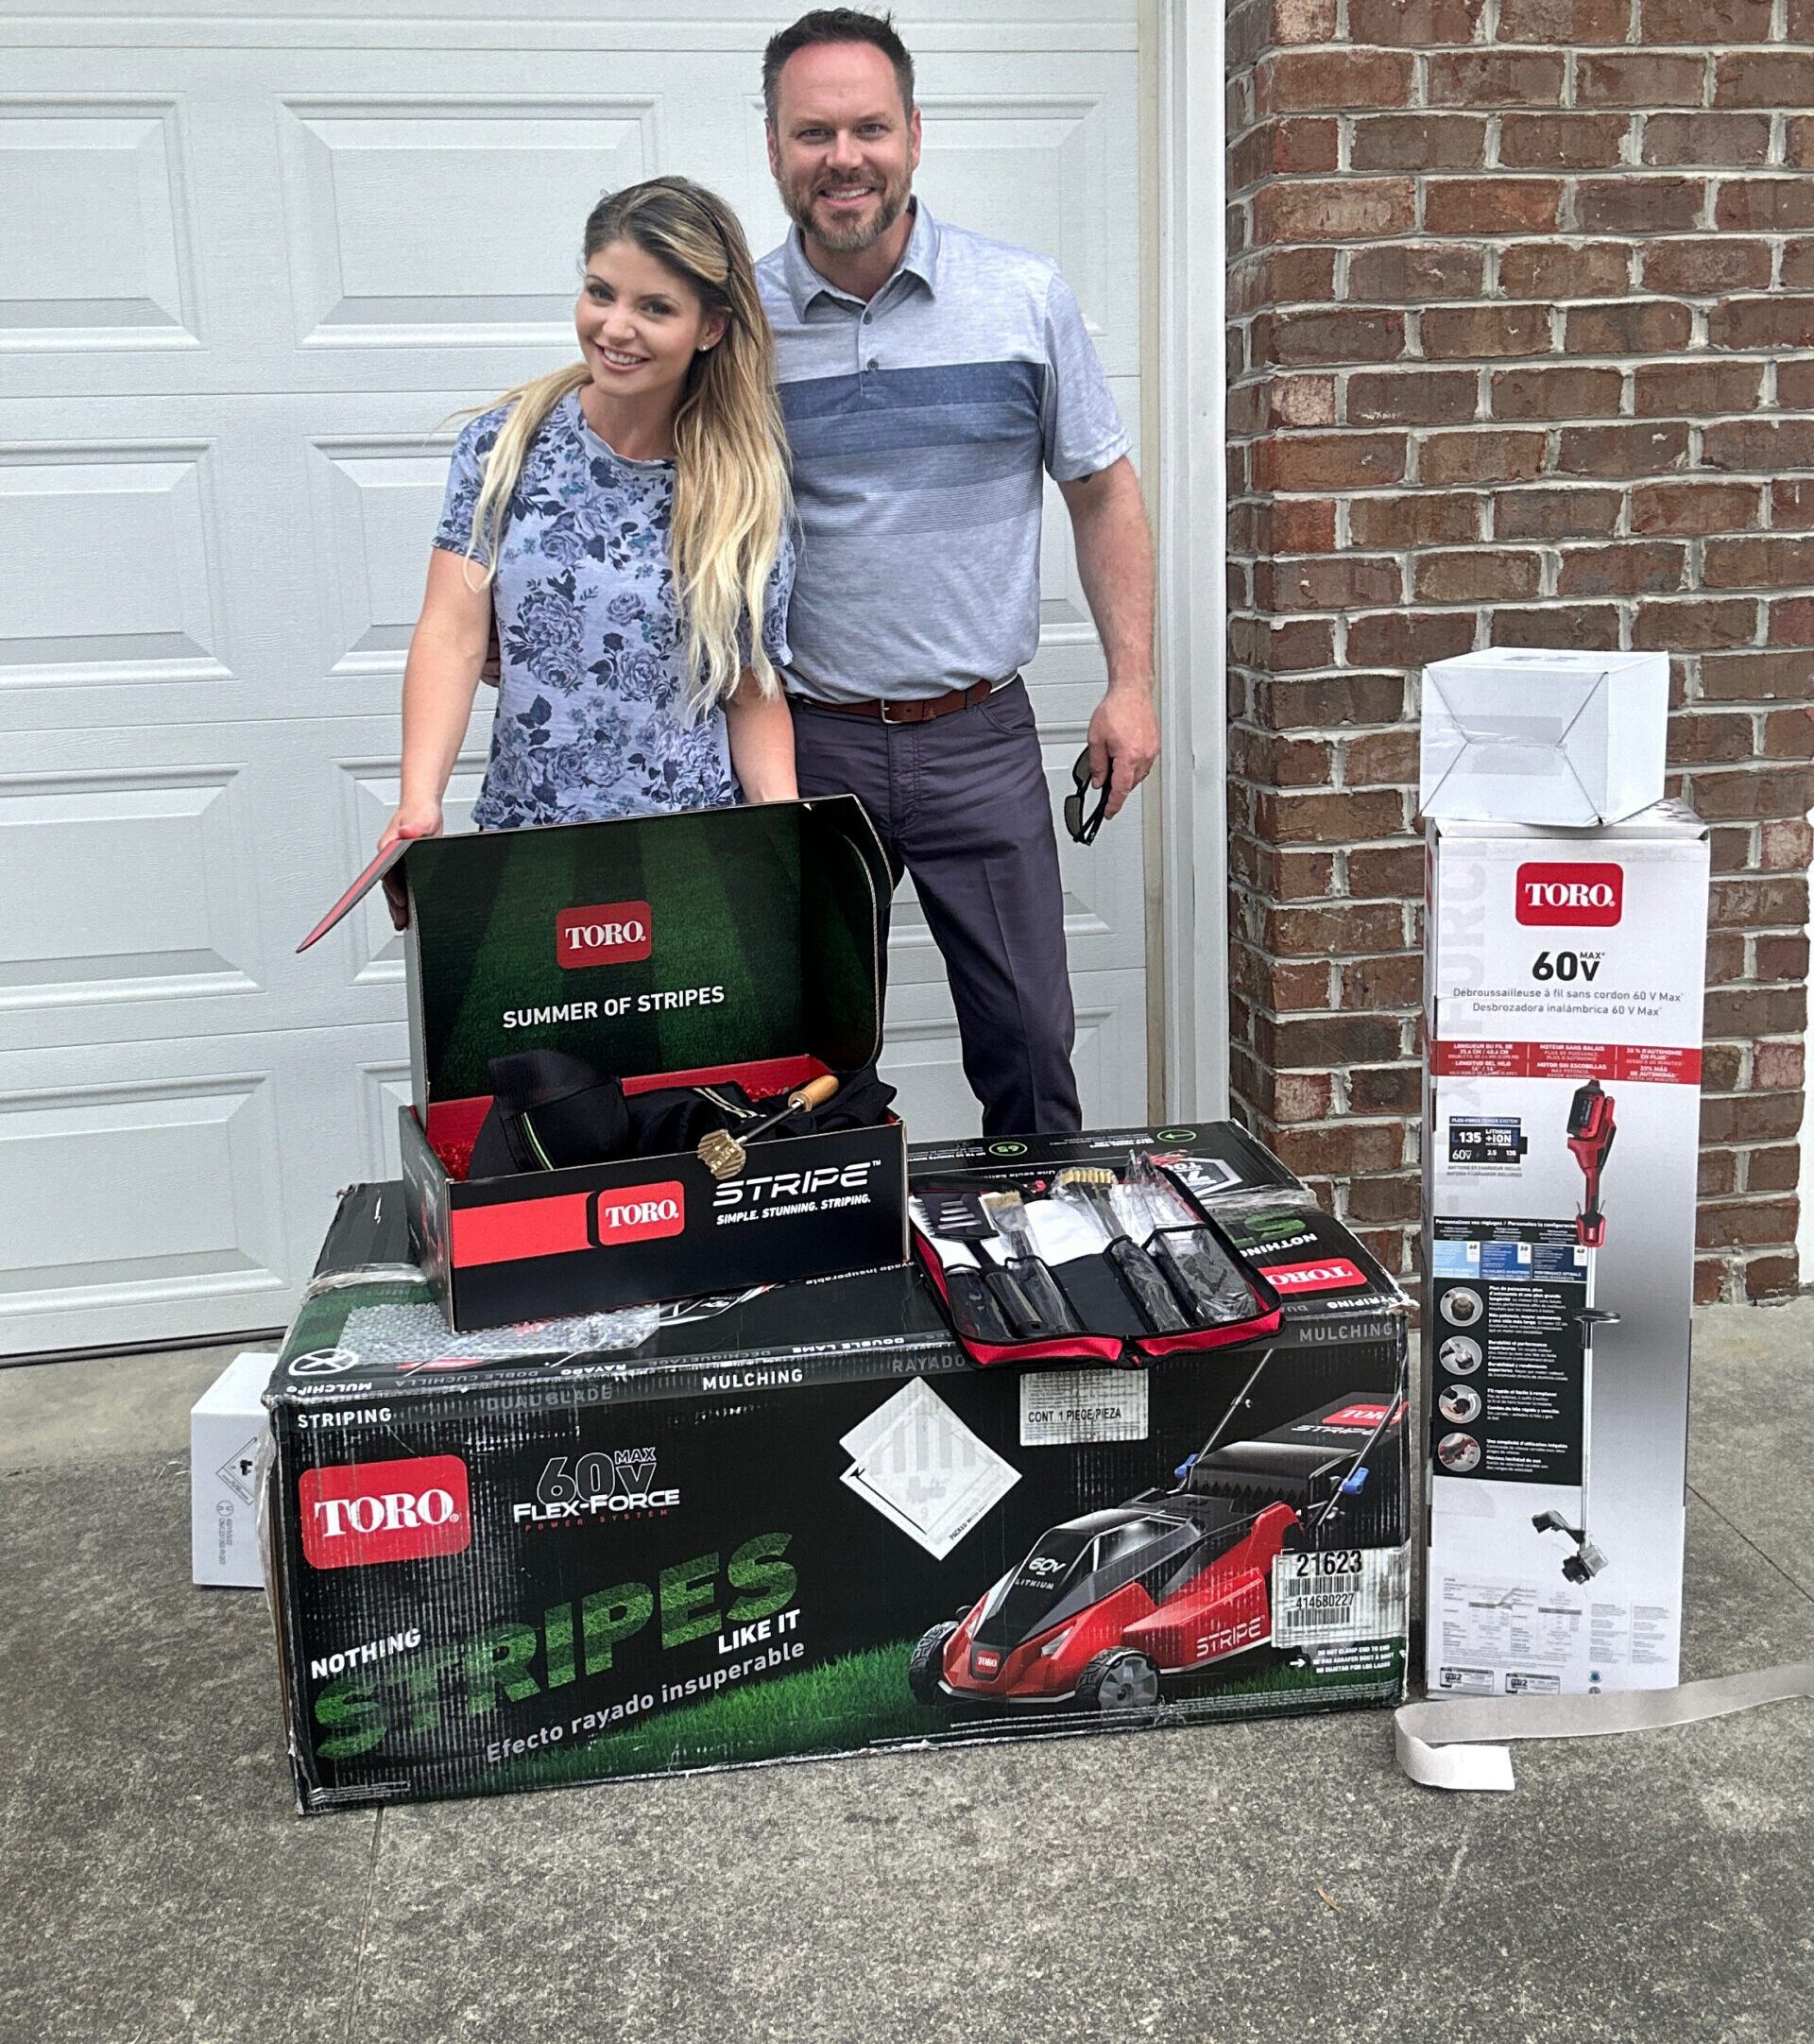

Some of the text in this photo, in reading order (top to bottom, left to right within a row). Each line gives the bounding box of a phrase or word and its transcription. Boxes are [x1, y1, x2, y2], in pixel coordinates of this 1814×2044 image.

[503, 986, 725, 1028] SUMMER OF STRIPES
[1473, 1003, 1544, 1012] Desbrozadora
[1612, 1005, 1625, 1014] 60
[1594, 990, 1630, 1000] cordon
[1633, 991, 1646, 1001] 60
[716, 1194, 872, 1226] SIMPLE. STUNNING. STRIPING.
[1299, 1322, 1394, 1343] MULCHING
[702, 1368, 803, 1392] MULCHING
[298, 1407, 392, 1430] STRIPING
[513, 1488, 680, 1523] FLEX-FORCE
[524, 1509, 669, 1533] POWER SYSTEM
[1296, 1550, 1363, 1577] 21623
[1295, 1592, 1355, 1610] 414680227
[717, 1608, 801, 1655] LIKE IT
[311, 1628, 422, 1679] NOTHING
[316, 1532, 798, 1760] STRIPES
[487, 1640, 805, 1764] Efecto rayado insuperable
